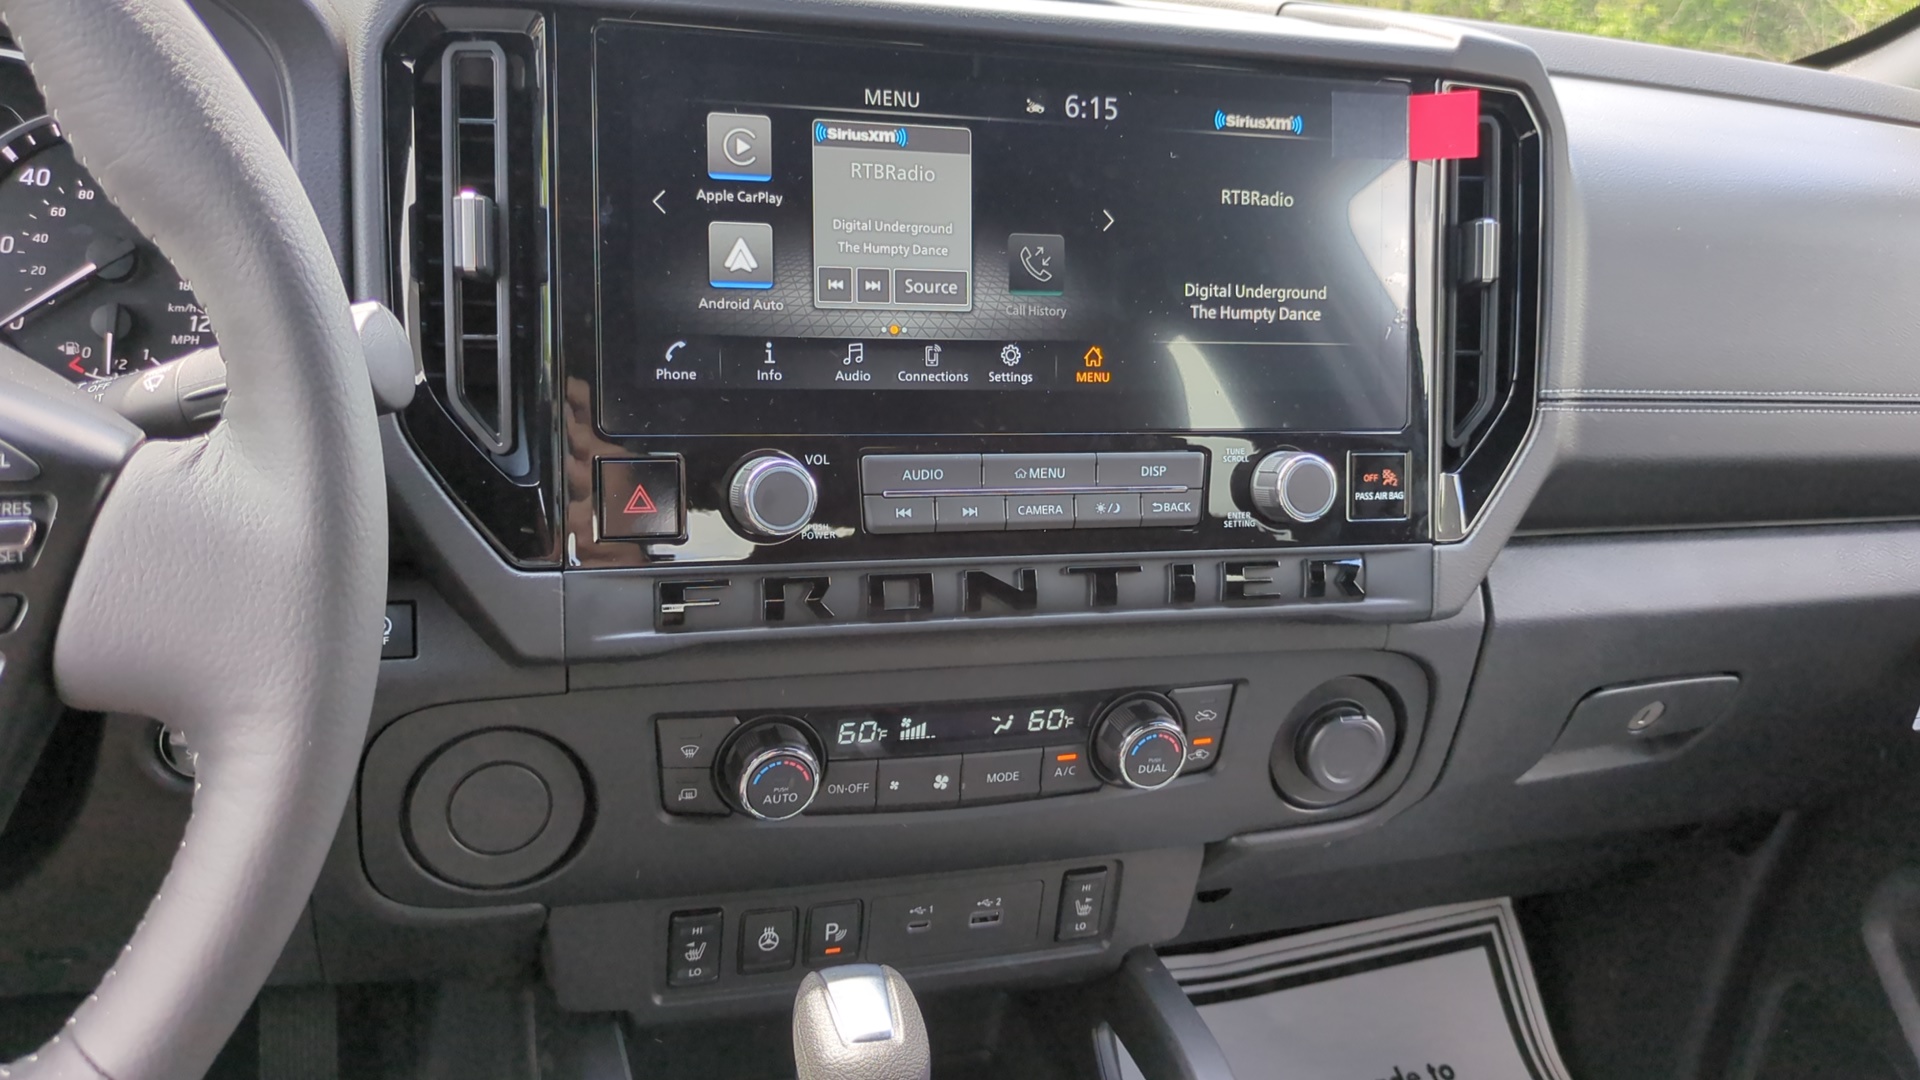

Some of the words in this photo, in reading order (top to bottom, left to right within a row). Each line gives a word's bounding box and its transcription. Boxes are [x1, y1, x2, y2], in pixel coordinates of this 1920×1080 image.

[864, 88, 920, 108] MENU
[1064, 94, 1118, 121] 6:15
[19, 168, 51, 187] 40
[850, 163, 936, 182] RTBRadio
[78, 190, 94, 200] 80
[696, 189, 734, 203] Apple
[737, 191, 783, 206] CarPlay
[1221, 189, 1294, 207] RTBRadio
[50, 207, 66, 217] 60
[832, 219, 872, 233] Digital
[874, 221, 953, 236] Underground
[32, 233, 49, 243] 40
[838, 241, 860, 254] The
[863, 242, 909, 257] Humpty
[912, 244, 949, 256] Dance
[31, 265, 46, 275] 20
[905, 278, 958, 294] Source
[1184, 284, 1231, 300] Digital
[1235, 285, 1327, 303] Underground
[168, 303, 197, 313] km/h
[698, 297, 750, 311] Android
[753, 299, 784, 311] Auto
[1005, 305, 1027, 317] Call
[1029, 306, 1067, 319] History
[1190, 305, 1217, 319] The
[1220, 307, 1275, 323] Humpty
[1279, 308, 1321, 321] Dance
[171, 334, 200, 345] MPH
[81, 346, 92, 359] 0
[143, 349, 150, 361] 1
[656, 369, 697, 380] Phone
[757, 370, 782, 380] Info
[835, 370, 871, 381] Audio
[898, 370, 969, 382] Connections
[988, 371, 1033, 384] Settings
[1076, 371, 1111, 383] MENU
[804, 454, 830, 465] VOL
[1223, 455, 1249, 463] SCROLL
[902, 469, 944, 481] AUDIO
[1028, 467, 1066, 479] MENU
[1140, 465, 1167, 477] DISP
[1363, 473, 1378, 483] OFF
[1355, 492, 1373, 500] PASS
[1375, 492, 1388, 500] AIR
[1389, 491, 1404, 500] BAG
[0, 502, 32, 516] RES
[1017, 504, 1063, 516] CAMERA
[1163, 502, 1191, 513] BACK
[807, 523, 829, 531] PUSH
[1223, 520, 1256, 528] SETTING
[801, 531, 836, 540] POWER
[656, 558, 1367, 630] FRONTIER
[1054, 766, 1076, 778] A/C
[1137, 763, 1168, 774] DUAL
[986, 770, 1020, 784] MODE
[762, 792, 798, 805] AUTO
[996, 898, 1002, 906] 2
[928, 905, 934, 913] 1
[692, 926, 703, 935] HI
[1075, 922, 1087, 931] LO
[688, 967, 702, 977] LO
